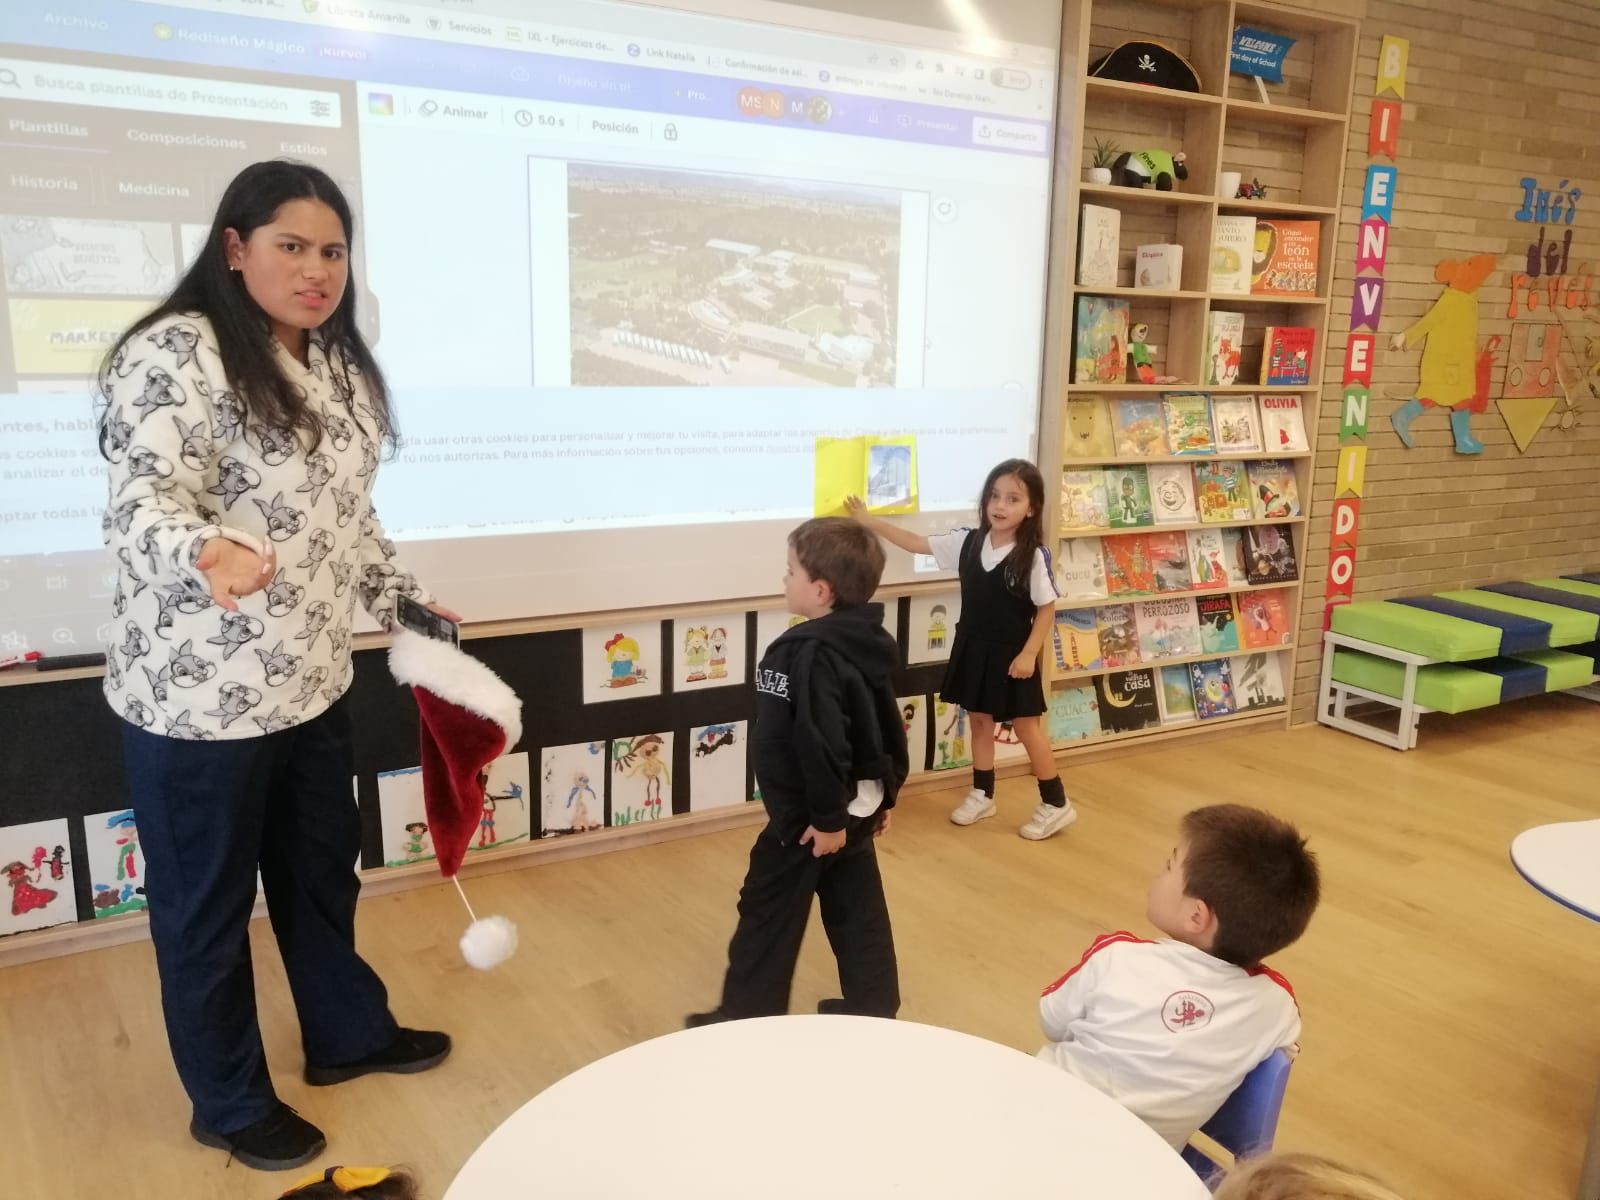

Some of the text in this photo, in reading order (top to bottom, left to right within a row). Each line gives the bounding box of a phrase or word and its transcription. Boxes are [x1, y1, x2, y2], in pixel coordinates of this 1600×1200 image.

[45, 12, 110, 31] Archivo
[177, 29, 249, 49] Rediseño
[254, 37, 305, 55] Mágico
[1239, 36, 1277, 53] WELCOME
[33, 74, 288, 111] Busca plantillas de Presentación
[443, 104, 488, 120] Animar
[9, 120, 88, 137] Plantillas
[592, 120, 639, 135] Posición
[127, 128, 247, 150] Composiciones
[280, 142, 327, 156] Estilos
[10, 175, 79, 191] Historia
[118, 181, 191, 198] Medicina
[1283, 243, 1310, 257] león
[1526, 226, 1573, 278] del
[1277, 259, 1314, 270] escuela
[50, 331, 121, 345] MARKET
[1264, 398, 1298, 409] OLIVIA
[0, 420, 49, 435] ntes,
[424, 435, 448, 446] usar
[452, 434, 483, 445] otras
[486, 432, 529, 444] cookies
[532, 433, 556, 445] para
[3, 464, 64, 480] analizar
[419, 453, 441, 463] nos
[503, 448, 528, 460] Para
[42, 505, 88, 520] todas
